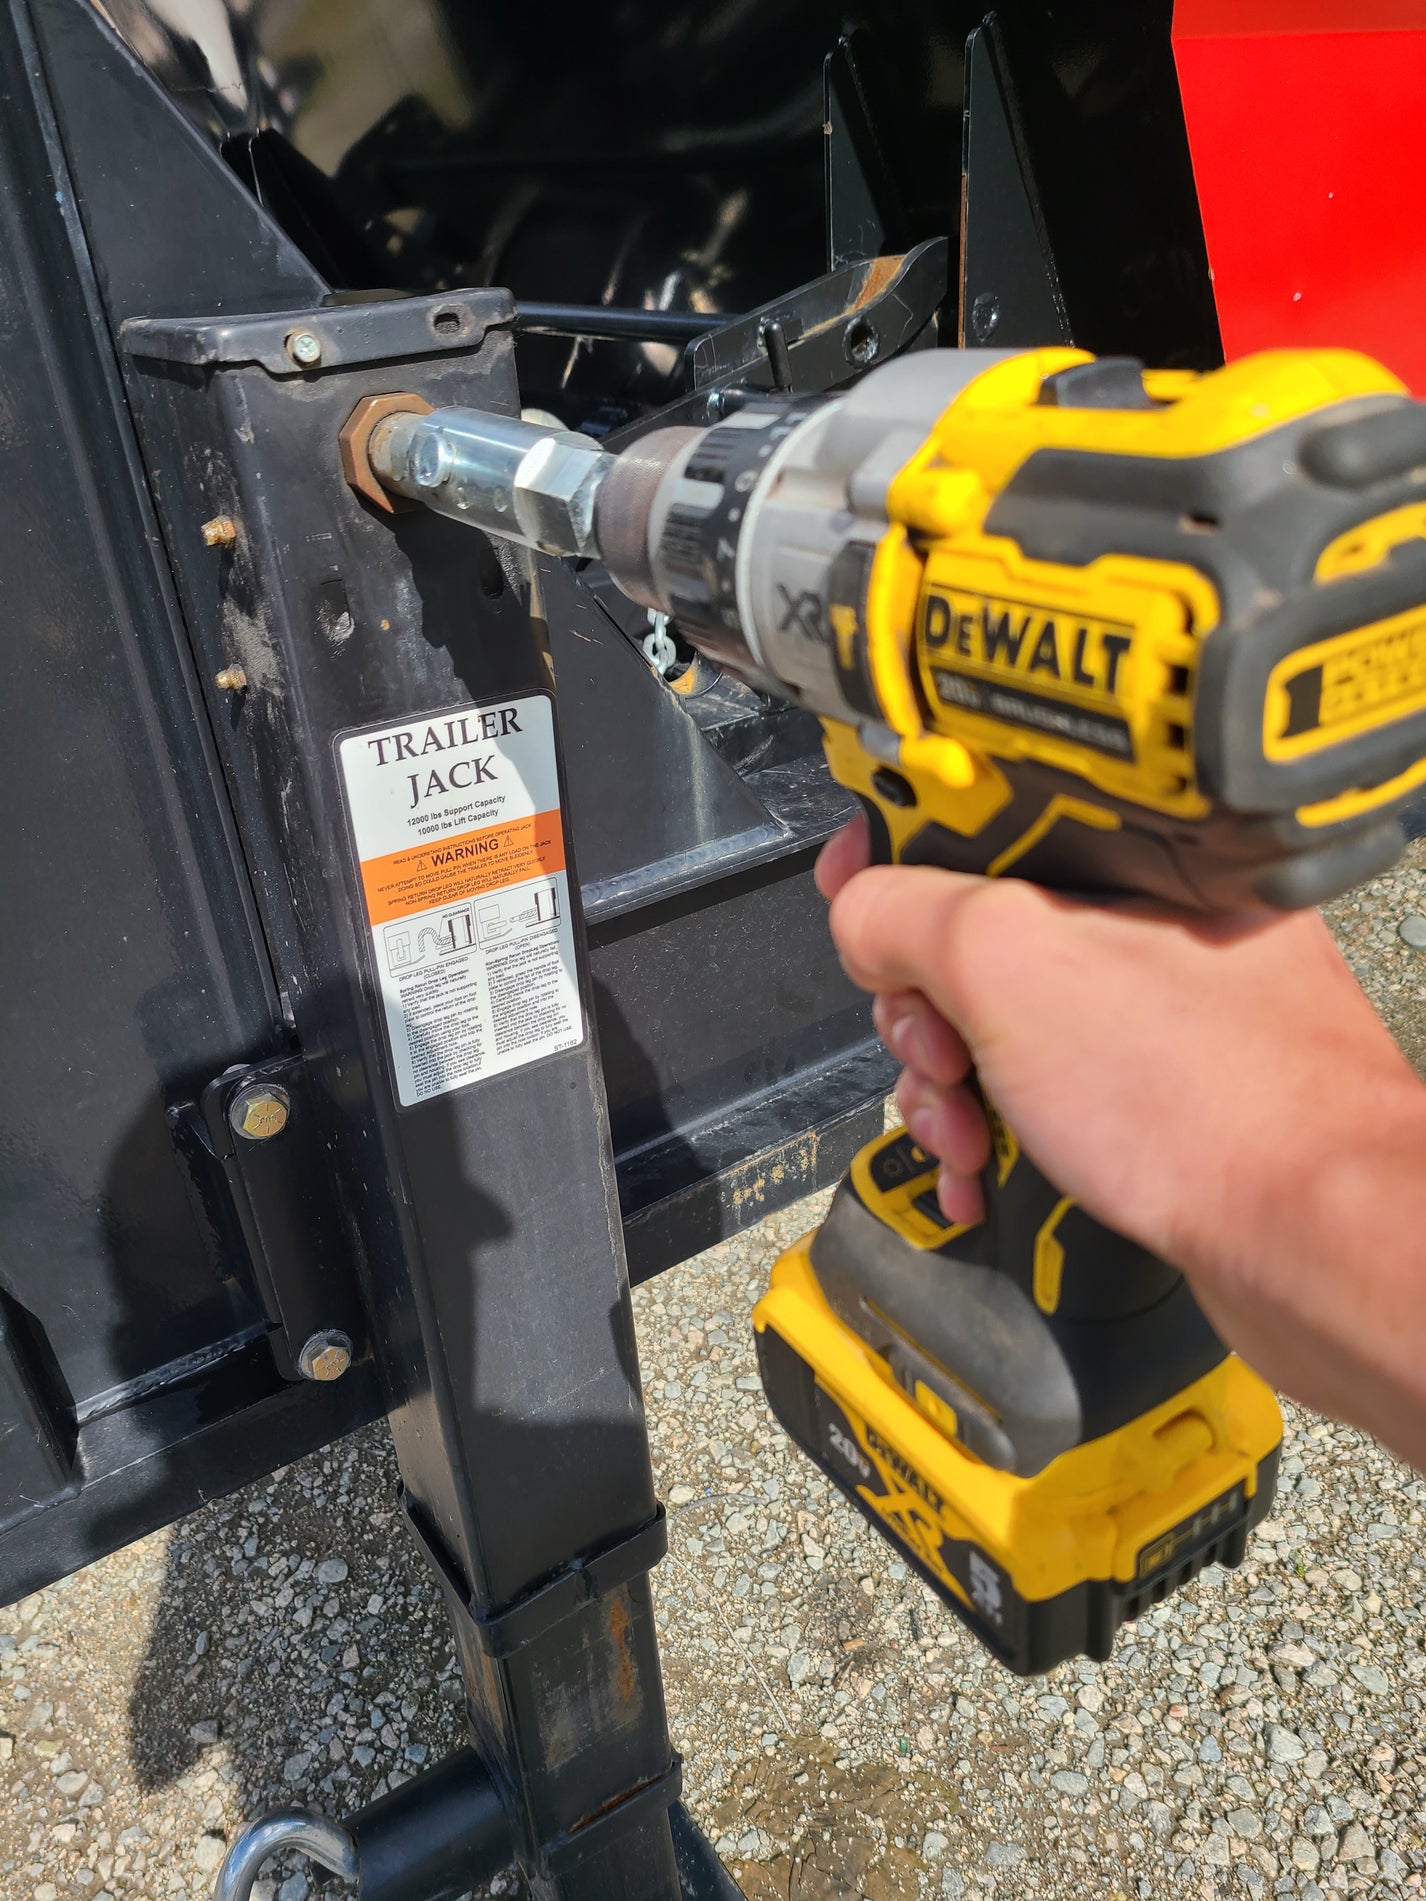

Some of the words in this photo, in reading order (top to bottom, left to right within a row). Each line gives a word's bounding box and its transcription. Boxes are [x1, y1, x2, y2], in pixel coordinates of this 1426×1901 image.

[368, 708, 522, 766] TRAILER
[408, 755, 498, 809] JACK
[407, 814, 430, 827] 12000
[430, 812, 443, 820] lbs
[443, 803, 474, 817] Support
[474, 795, 506, 809] Capacity
[417, 823, 440, 836] 10000
[440, 821, 453, 829] lbs
[453, 816, 467, 826] Lift
[467, 809, 499, 823] Capacity
[410, 847, 443, 860] UNDERSTAND
[442, 838, 476, 852] INSTRUCTIONS
[476, 833, 495, 842] BEFORE
[494, 826, 520, 836] OPERATING
[431, 838, 499, 867] WARNING
[377, 883, 395, 892] NEVER
[394, 876, 418, 888] ATTEMPT
[425, 870, 440, 878] MOVE
[462, 860, 477, 868] WHEN
[476, 855, 493, 863] THERE
[508, 847, 522, 855] LOAD
[387, 896, 408, 905] SPRING
[407, 890, 428, 900] RETURN
[427, 885, 443, 894] DROP
[464, 871, 492, 884] NATURALLY
[491, 865, 513, 875] RETRACT
[397, 883, 415, 892] DOING
[422, 876, 441, 885] COULD
[440, 871, 457, 880] CAUSE
[467, 862, 488, 871] TRAILER
[494, 856, 509, 864] MOVE
[405, 893, 437, 906] NON-SPRING
[436, 887, 457, 896] RETURN
[456, 883, 471, 891] DROP
[492, 869, 519, 881] NATURALLY
[428, 896, 442, 904] KEEP
[442, 891, 459, 900] CLEAR
[466, 884, 486, 893] MOVING
[485, 946, 499, 954] DROP
[508, 937, 529, 946] PULL-PIN
[529, 928, 559, 941] DISENGAGED
[514, 941, 531, 950] (OPEN)
[398, 973, 413, 982] DROP
[423, 964, 446, 973] PULL-PIN
[445, 956, 469, 968] ENGAGED
[423, 968, 447, 980] (CLOSED)
